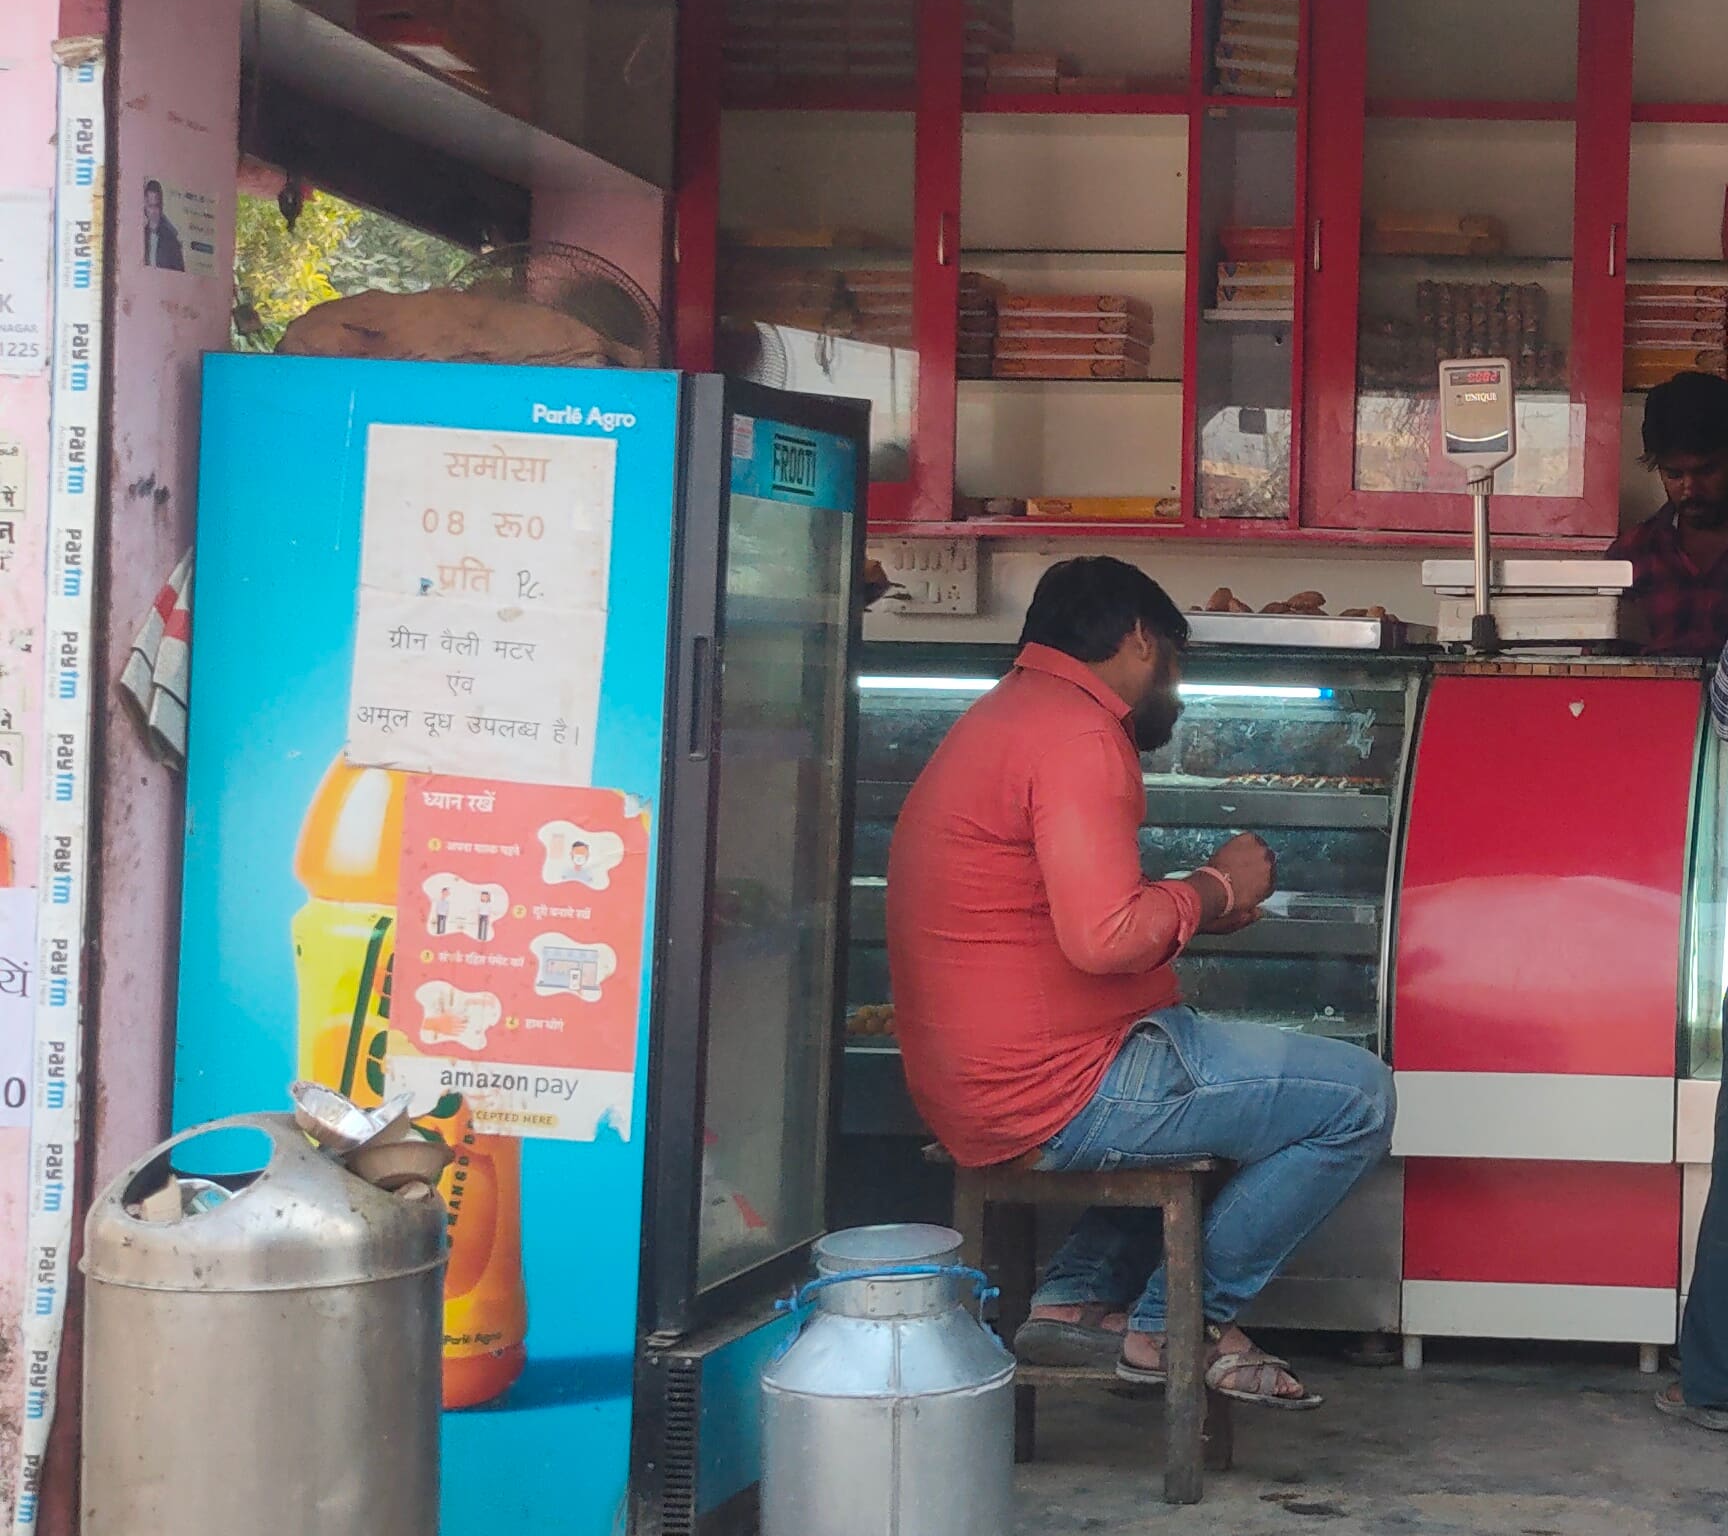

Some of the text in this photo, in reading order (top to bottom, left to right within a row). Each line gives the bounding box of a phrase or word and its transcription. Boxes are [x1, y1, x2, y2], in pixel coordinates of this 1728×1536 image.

[585, 406, 636, 433] Agro
[444, 443, 552, 483] समोसा
[436, 556, 495, 593] प्रति
[388, 624, 536, 662] ग्रीन वैली मटर
[356, 705, 412, 734] अमूल
[423, 710, 455, 738] दूध
[466, 714, 541, 741] उपलब्ध
[422, 789, 497, 813] ध्यान रखें
[440, 1068, 579, 1101] amazon pay
[523, 1112, 553, 1126] HERE
